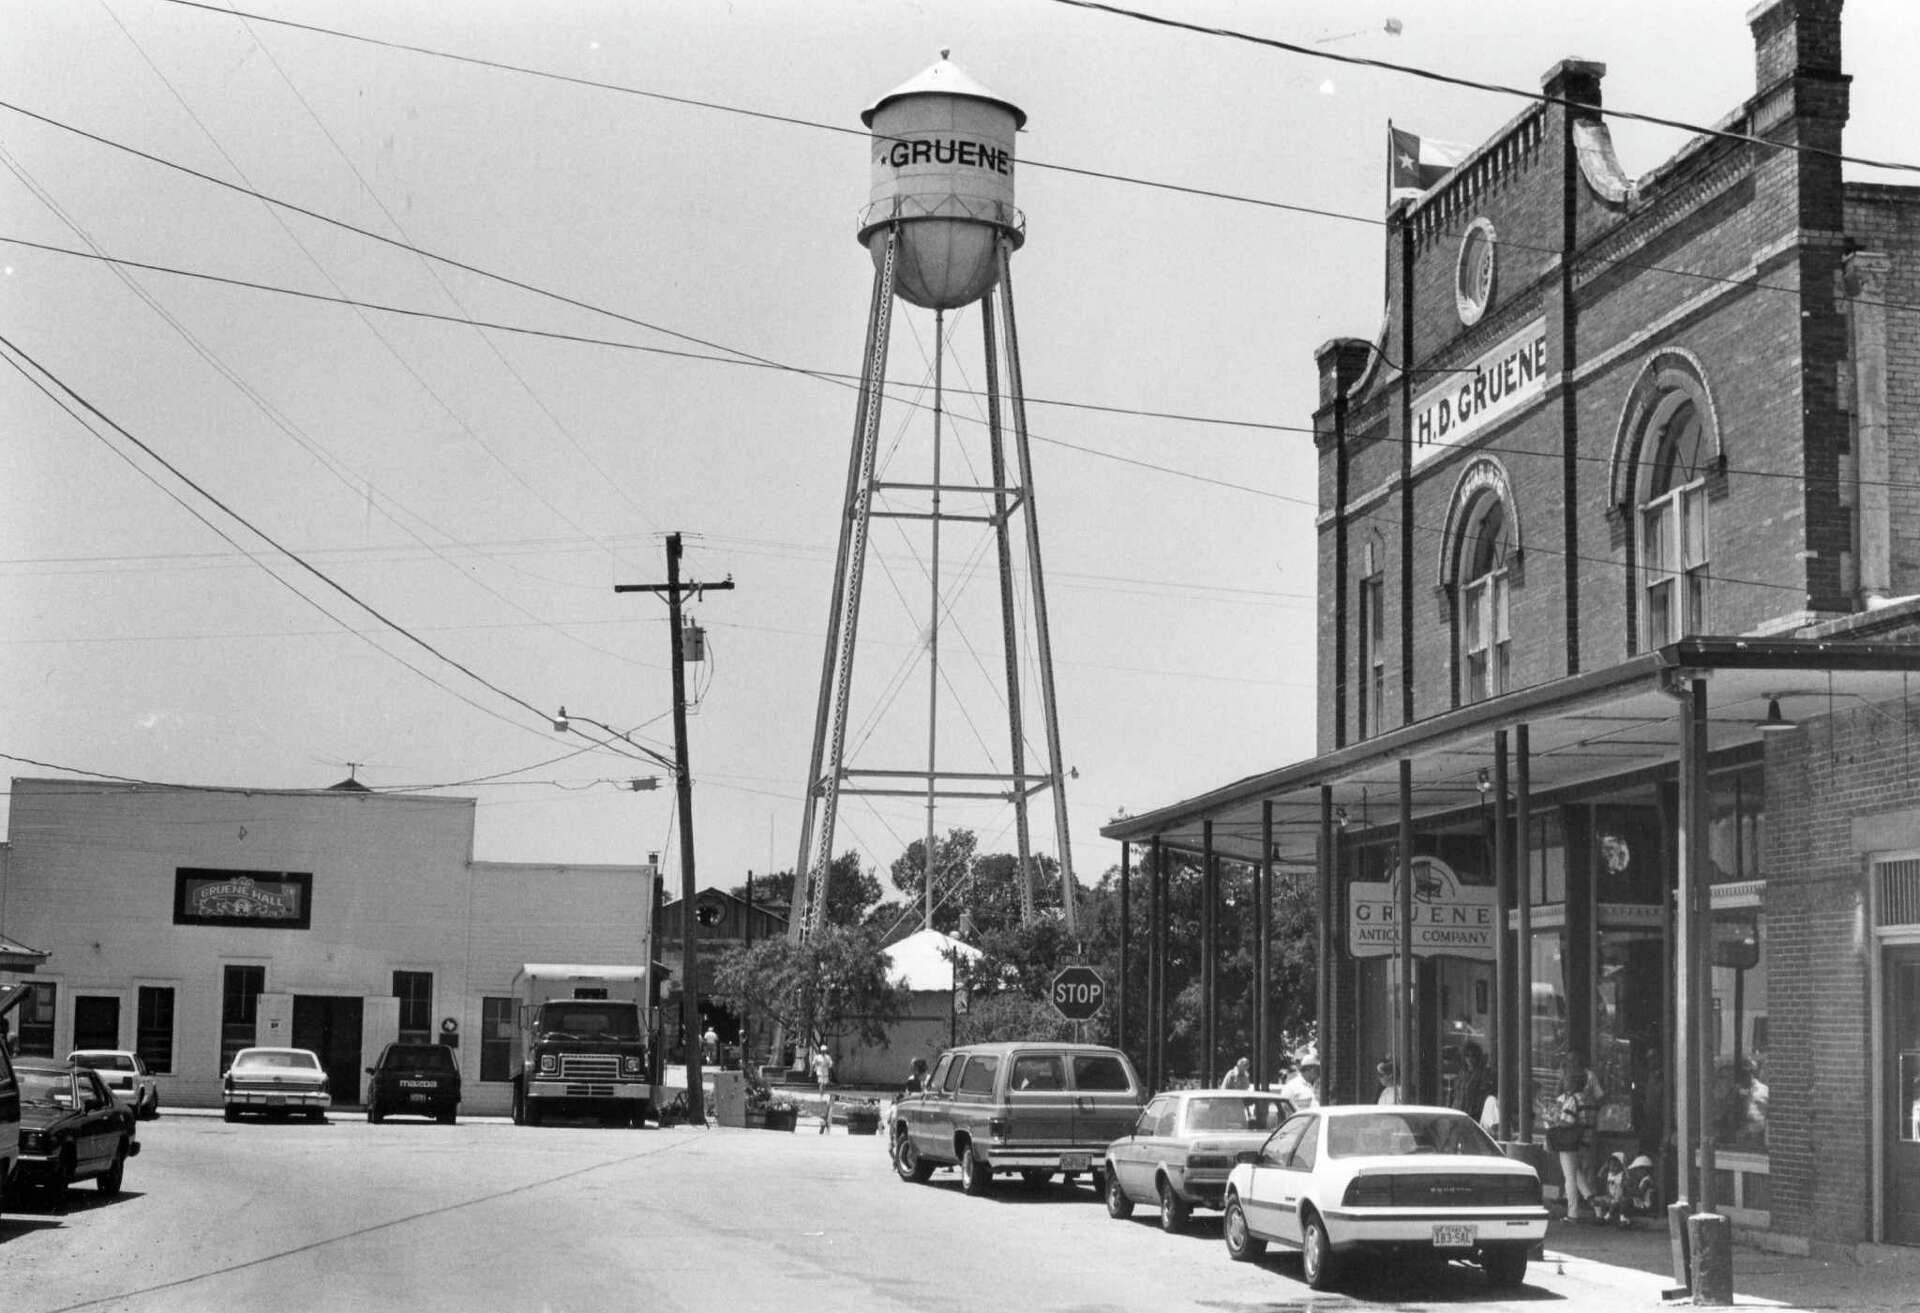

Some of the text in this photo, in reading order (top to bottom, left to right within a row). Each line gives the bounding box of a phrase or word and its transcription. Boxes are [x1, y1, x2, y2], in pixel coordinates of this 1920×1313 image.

[890, 139, 1009, 176] GRUENE
[201, 885, 283, 906] GRUENE HALL
[1422, 930, 1488, 944] COMPANY
[1056, 983, 1101, 1004] STOP
[400, 1080, 437, 1088] mazda
